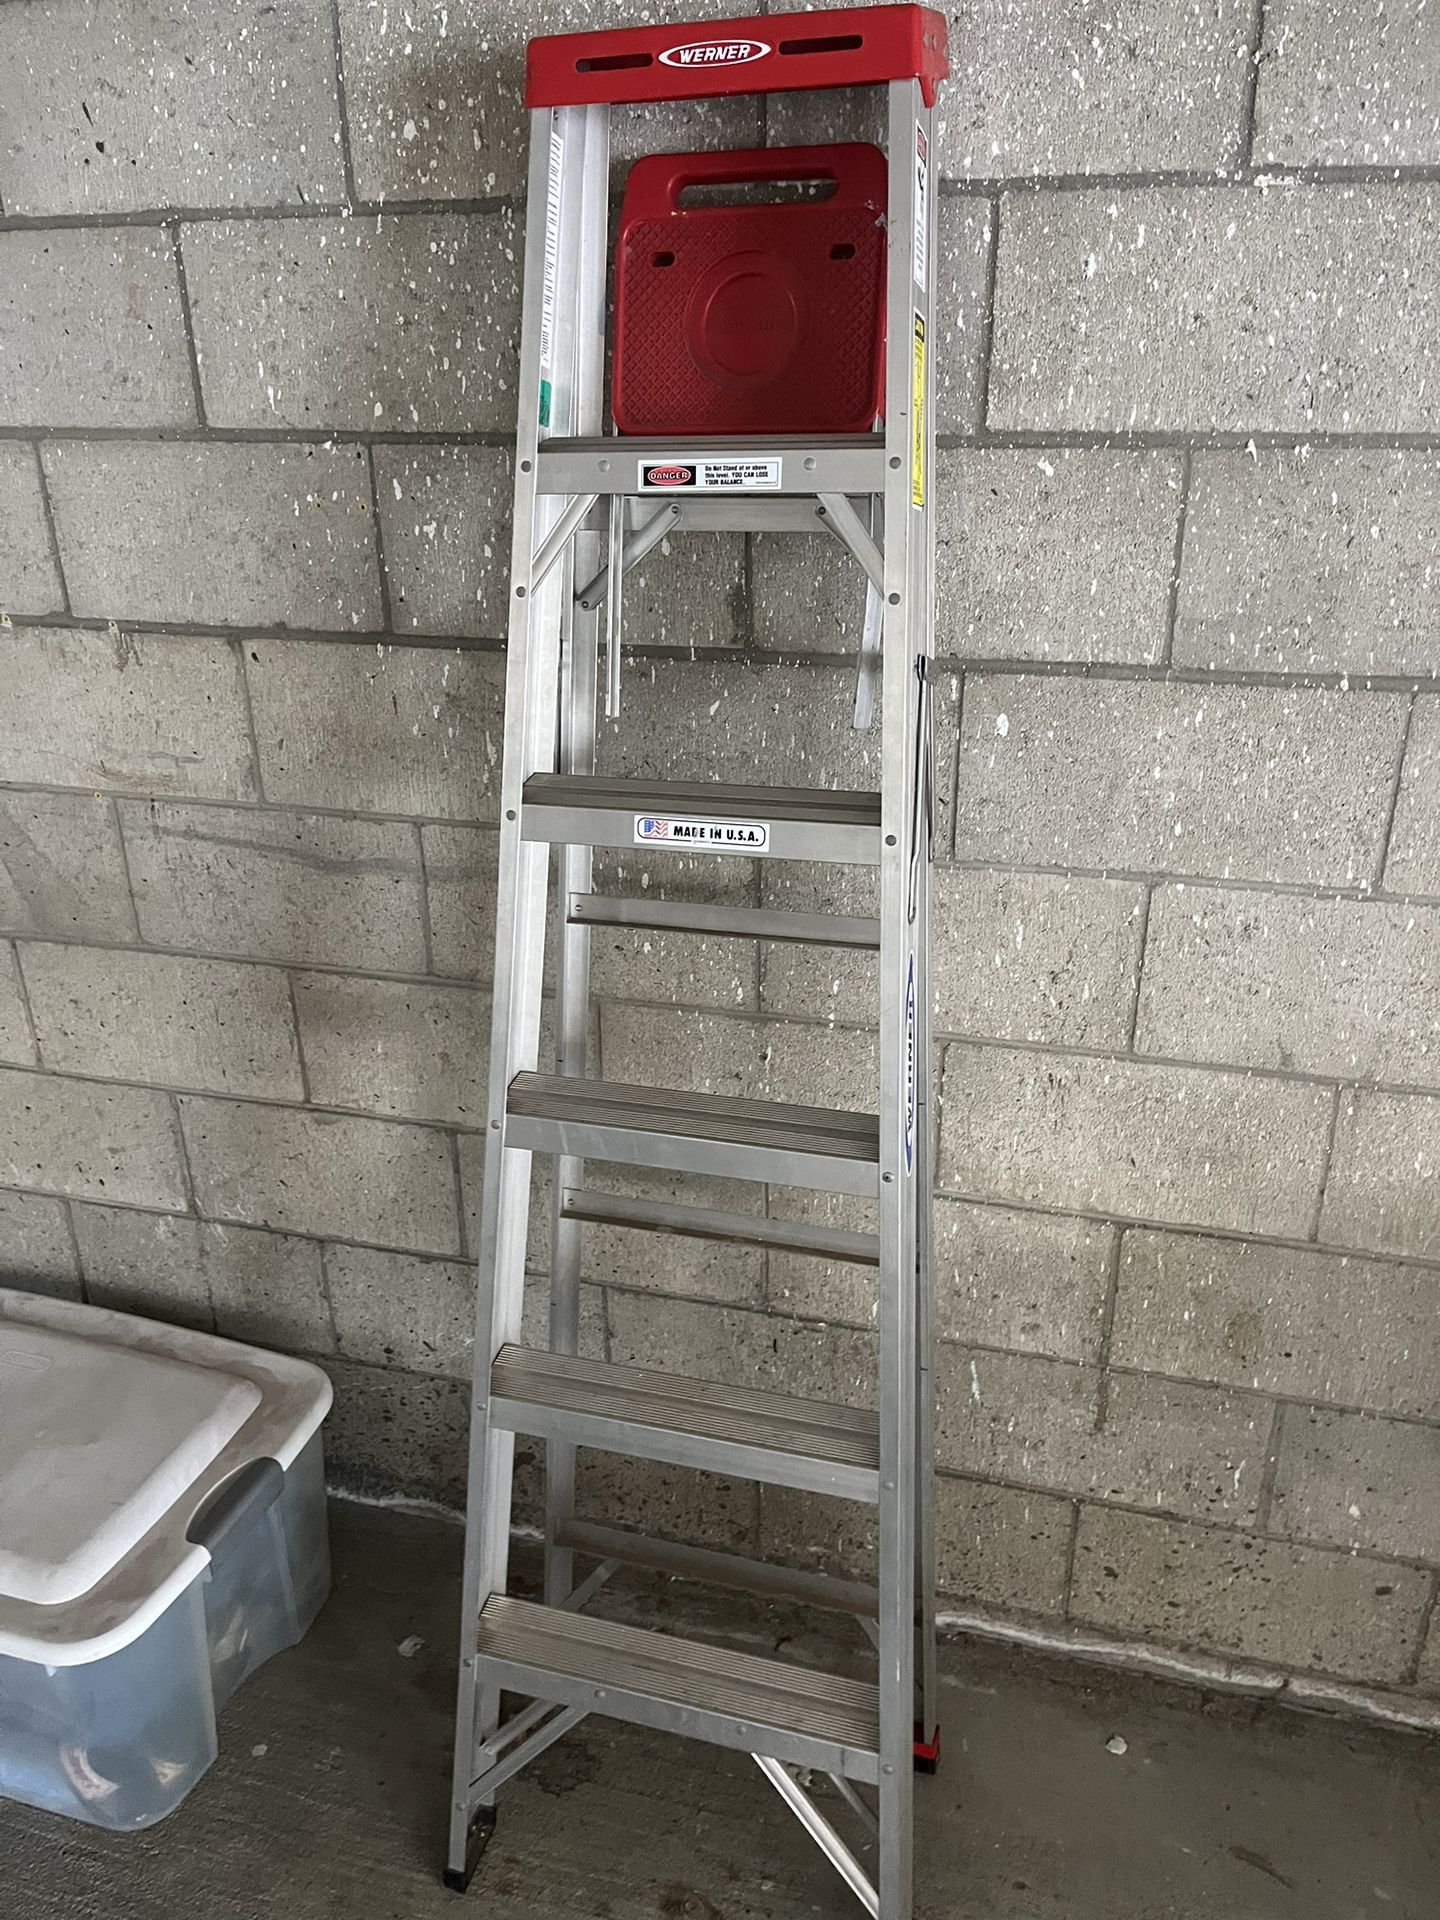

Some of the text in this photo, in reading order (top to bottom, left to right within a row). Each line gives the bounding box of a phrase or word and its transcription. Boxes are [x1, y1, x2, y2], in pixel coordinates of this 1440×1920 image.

[680, 45, 751, 63] WERNER
[650, 470, 688, 480] DANGER
[674, 826, 759, 842] MADE IN U.S.A.
